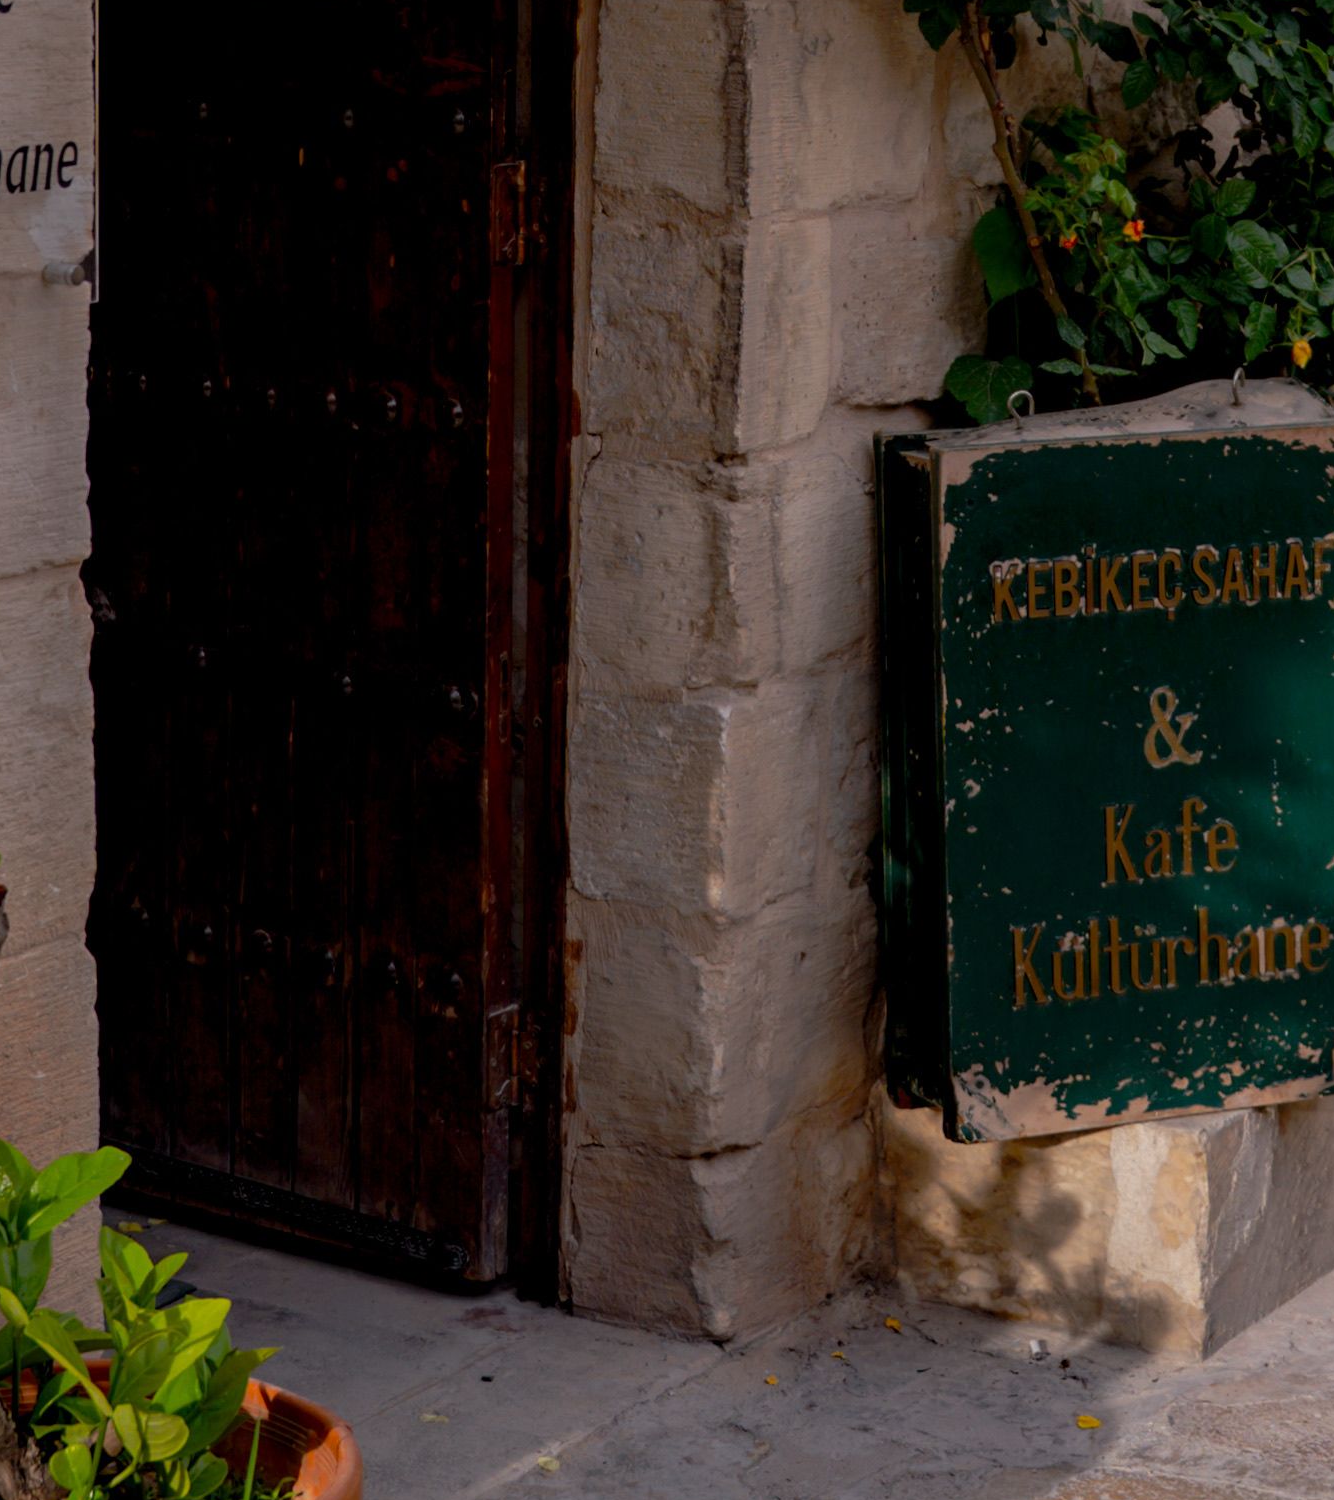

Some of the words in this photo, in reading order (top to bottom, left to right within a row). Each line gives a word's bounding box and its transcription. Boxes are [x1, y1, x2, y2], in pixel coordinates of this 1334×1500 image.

[990, 546, 1183, 623] KEBİKEÇ
[1144, 685, 1203, 769] &
[1101, 796, 1240, 888] Kafe
